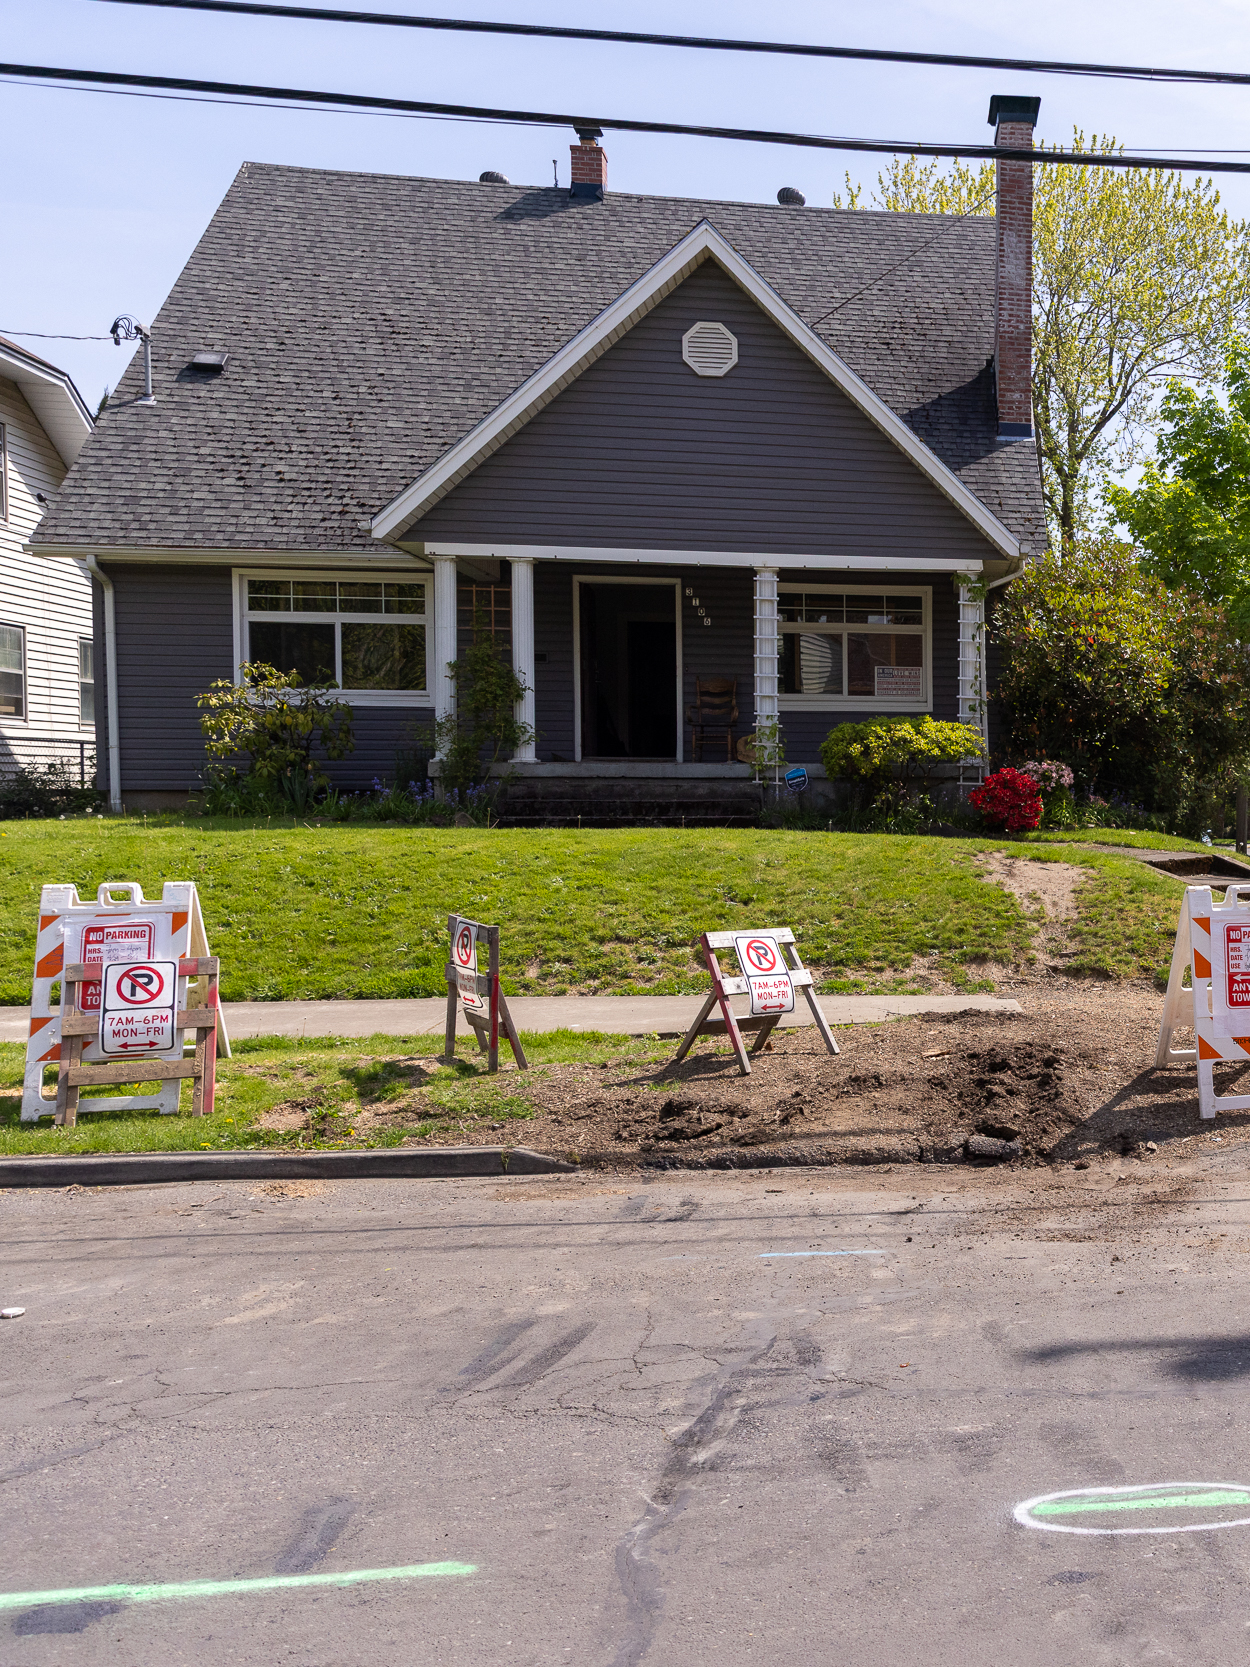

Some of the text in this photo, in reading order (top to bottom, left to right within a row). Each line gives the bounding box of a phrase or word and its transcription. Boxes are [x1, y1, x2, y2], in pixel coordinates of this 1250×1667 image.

[686, 587, 711, 625] 3106
[89, 929, 147, 941] NO PARKING
[1229, 930, 1241, 940] NO
[87, 947, 104, 955] HRS.
[87, 955, 104, 963] DATE
[86, 996, 100, 1005] TO
[1232, 992, 1250, 1002] TOW
